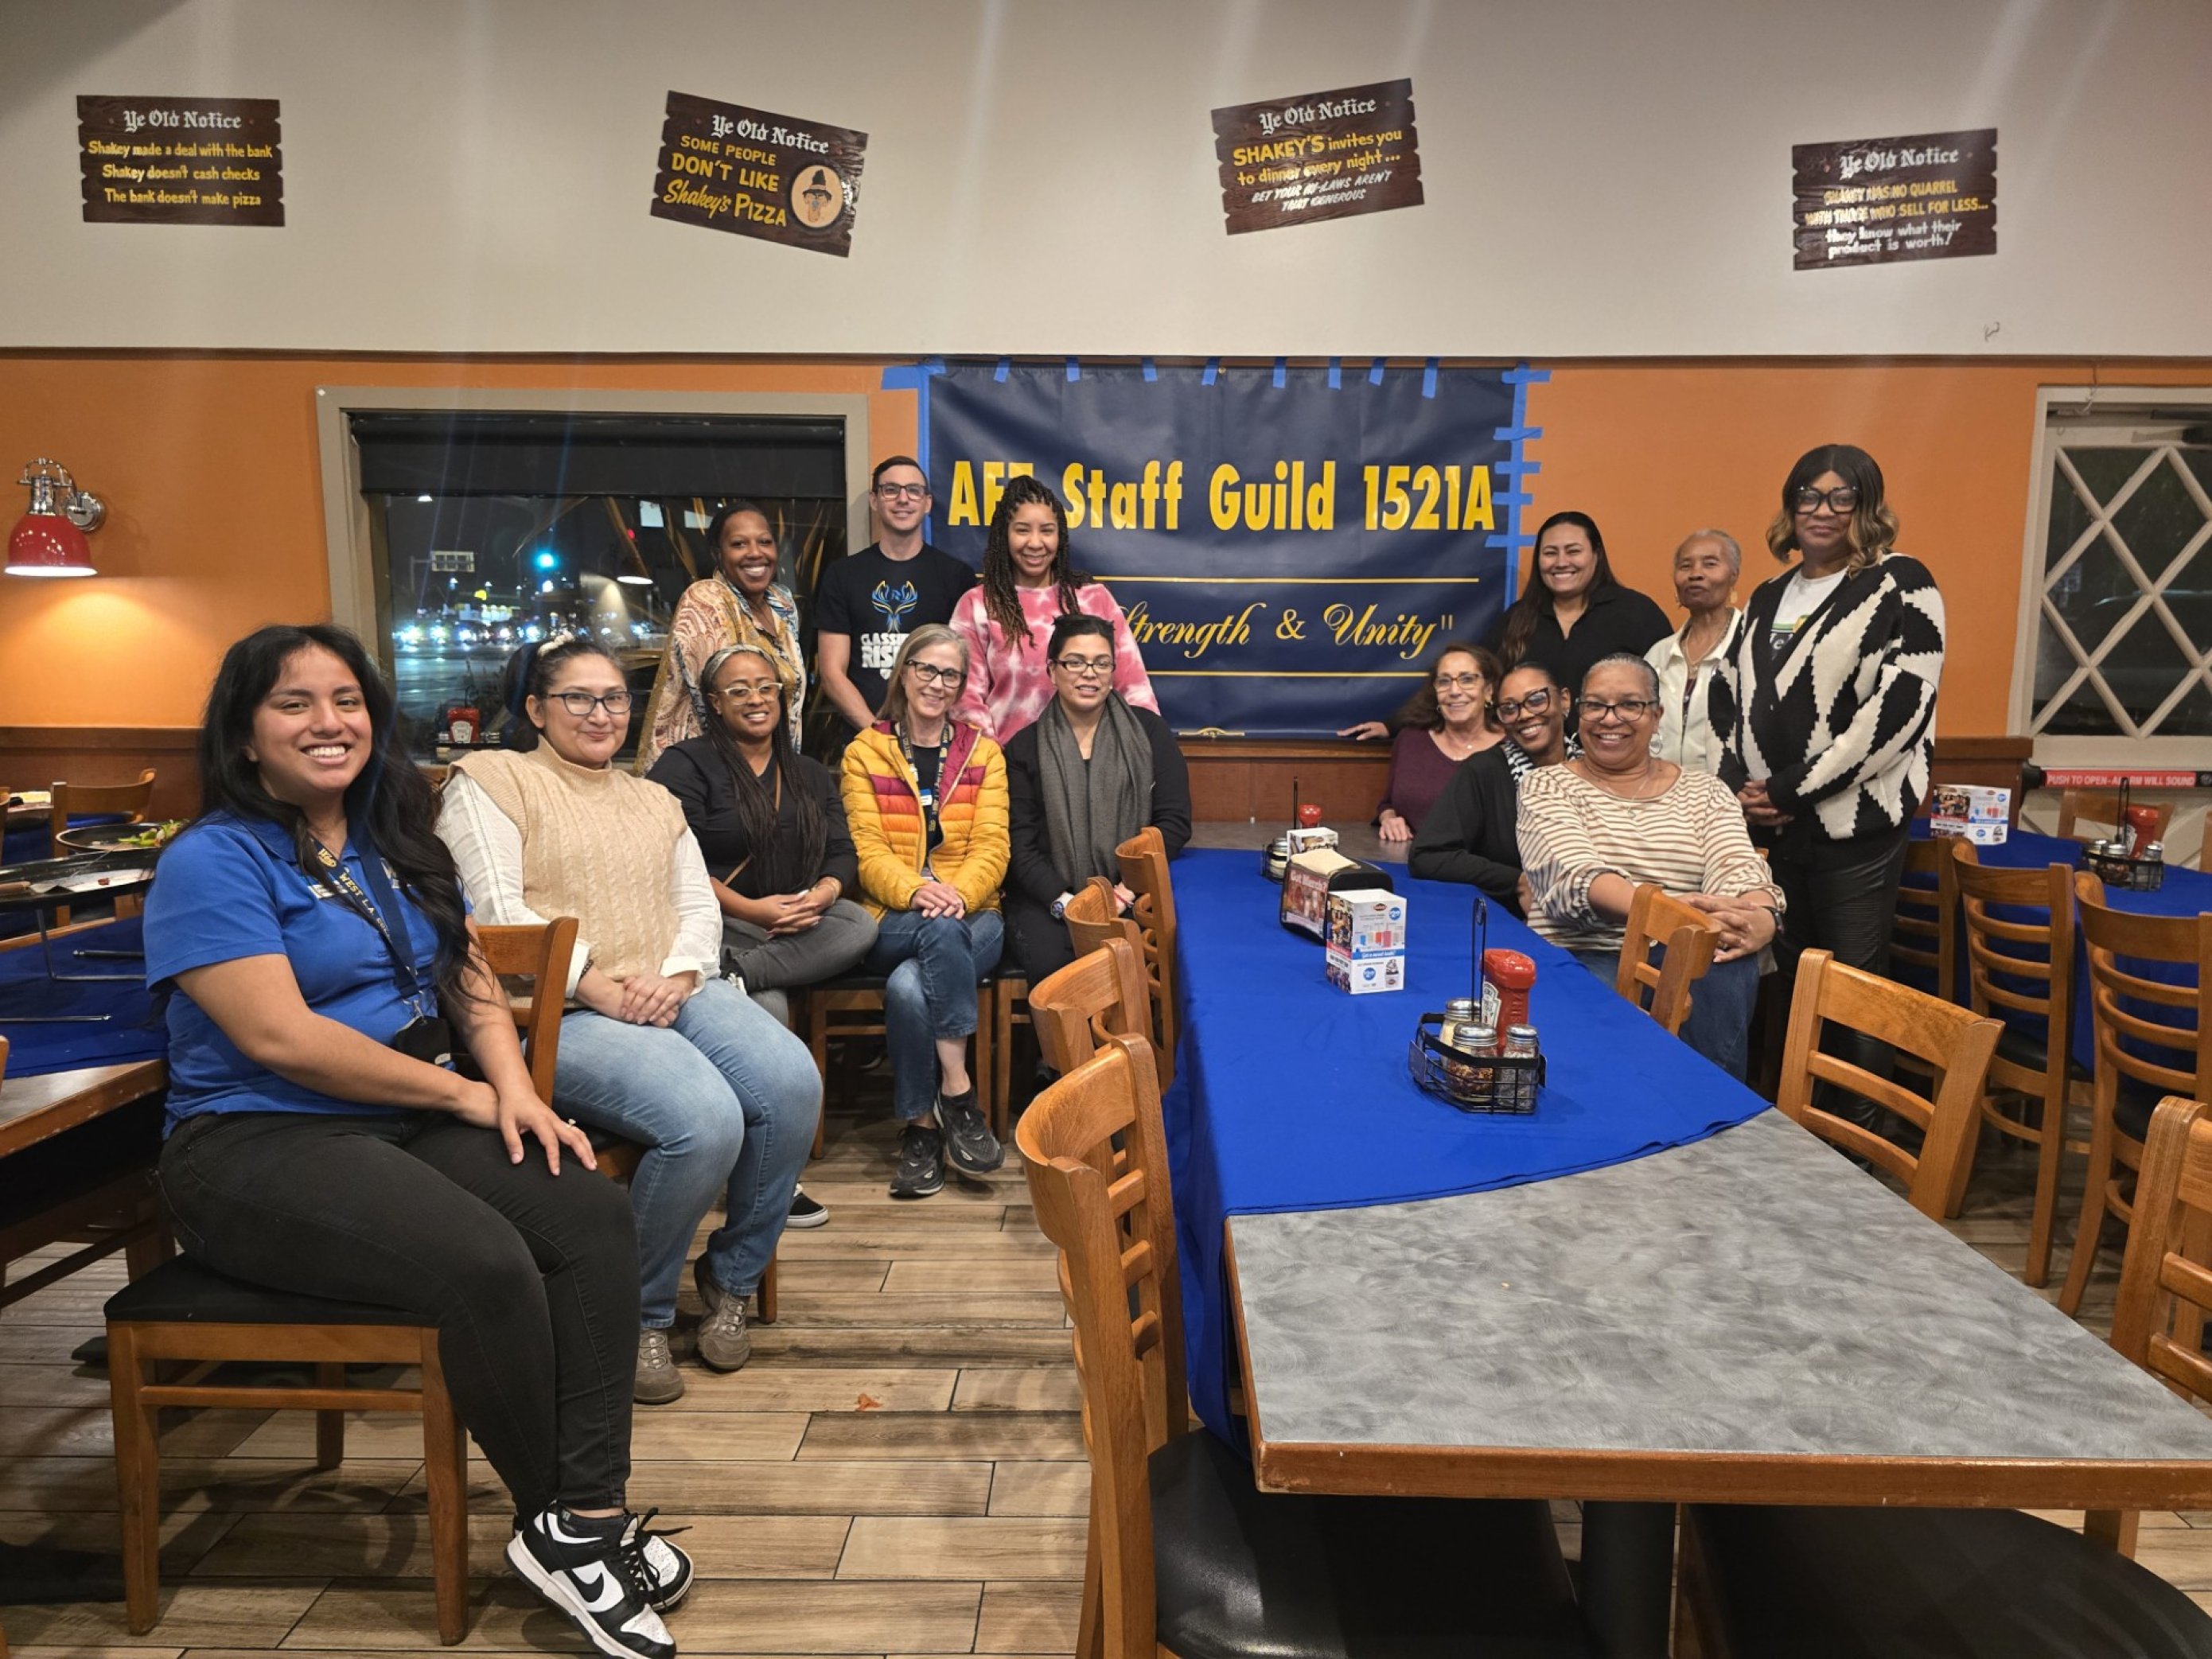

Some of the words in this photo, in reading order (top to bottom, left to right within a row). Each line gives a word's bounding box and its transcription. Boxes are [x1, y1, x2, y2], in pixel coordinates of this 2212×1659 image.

[123, 110, 146, 134] Ye
[148, 109, 180, 127] Old
[183, 111, 242, 128] Notice
[1259, 112, 1283, 136] Ye
[1284, 105, 1314, 126] Old
[1318, 98, 1377, 120] Notice
[711, 115, 734, 138] Ye
[737, 119, 769, 140] Old
[771, 127, 828, 154] Notice
[88, 140, 130, 159] Shakey
[132, 142, 162, 157] made
[166, 146, 173, 155] a
[174, 142, 197, 157] deal
[199, 142, 224, 158] with
[224, 142, 245, 158] the
[247, 144, 273, 158] bank
[680, 135, 719, 154] SOME
[726, 144, 777, 166] PEOPLE
[1233, 135, 1325, 166] SHAKEY'S
[1328, 132, 1374, 150] invites
[1376, 130, 1402, 147] you
[1863, 149, 1897, 173] Old
[1900, 146, 1959, 168] Notice
[102, 163, 145, 183] Shakey
[146, 165, 189, 179] doesn't
[193, 166, 220, 180] cash
[221, 166, 260, 181] checks
[672, 152, 733, 181] DON'T
[739, 168, 779, 193] LIKE
[1237, 171, 1256, 186] to
[1258, 167, 1301, 183] dinner
[1303, 161, 1342, 177] every
[104, 187, 127, 203] The
[129, 189, 156, 203] bank
[157, 189, 198, 204] doesn't
[201, 192, 230, 204] make
[232, 192, 261, 209] pizza
[1273, 184, 1303, 201] YOUR
[1892, 184, 1907, 199] NO
[1910, 180, 1958, 197] QUARREL
[663, 178, 731, 219] Shakey's
[734, 193, 786, 227] PIZZA
[1899, 202, 1925, 216] SELL
[1928, 200, 1949, 215] FOR
[1825, 228, 1857, 245] they
[1859, 225, 1893, 240] know
[1897, 221, 1928, 236] what
[1931, 220, 1962, 233] their
[1828, 238, 1882, 260] product
[1887, 238, 1899, 251] is
[1905, 232, 1953, 249] worth!
[1062, 460, 1183, 530] Staff
[1209, 460, 1336, 531] Guild
[1363, 465, 1495, 531] 1521A
[1275, 609, 1307, 640] &
[2047, 775, 2070, 785] PUSH
[2072, 775, 2082, 785] TO
[2144, 776, 2163, 786] WILL
[2166, 776, 2195, 786] SOUND
[339, 872, 364, 896] WEST
